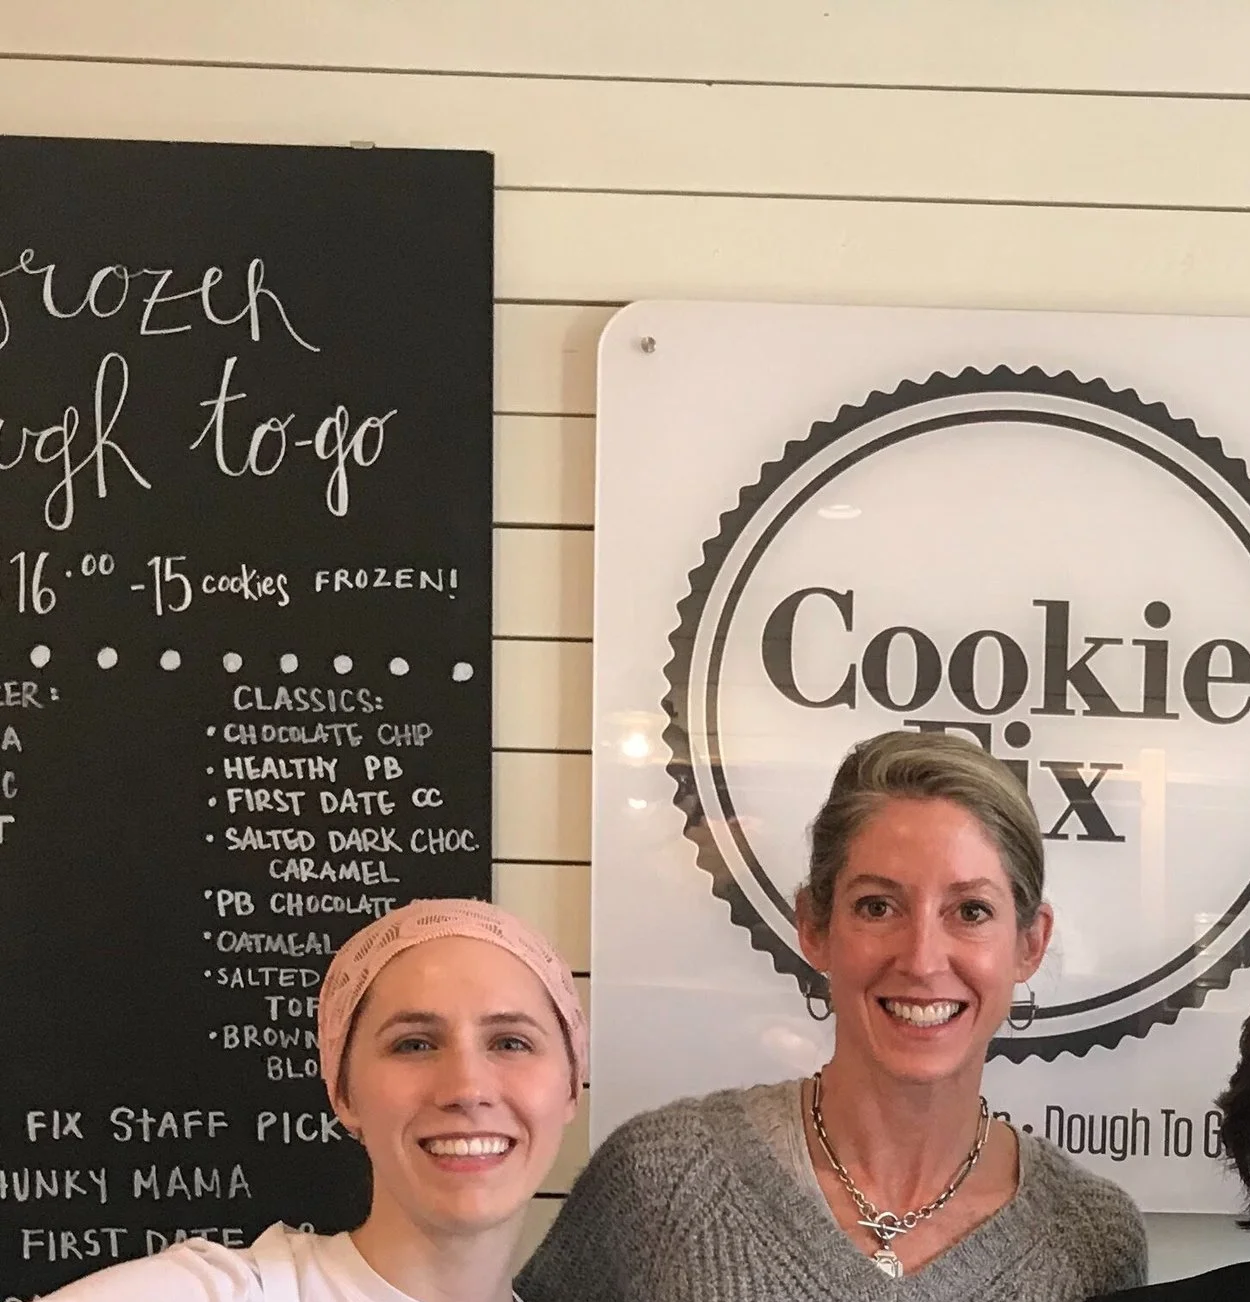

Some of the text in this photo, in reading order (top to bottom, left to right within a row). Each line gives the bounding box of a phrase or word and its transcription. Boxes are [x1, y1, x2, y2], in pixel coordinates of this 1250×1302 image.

[190, 356, 398, 517] to-go
[315, 569, 458, 598] FROZEN!
[233, 685, 384, 713] CLASSICS:
[224, 723, 432, 746] CHOCOLATE CHIP
[224, 757, 403, 782] HEALTHY PB
[227, 789, 305, 816] FIRST
[321, 790, 395, 816] DATE
[226, 829, 480, 853] SALTED DARK CHOC.
[269, 859, 400, 884] CARAMEL
[216, 891, 255, 917] PB
[216, 931, 337, 957] OATMEAL
[217, 967, 320, 989] SALTED
[27, 1110, 84, 1143] FIX
[257, 1110, 364, 1145] PICK
[1045, 1104, 1150, 1162] Dough
[1160, 1108, 1193, 1158] To
[133, 1163, 252, 1201] MAMA
[21, 1228, 128, 1262] FIRST
